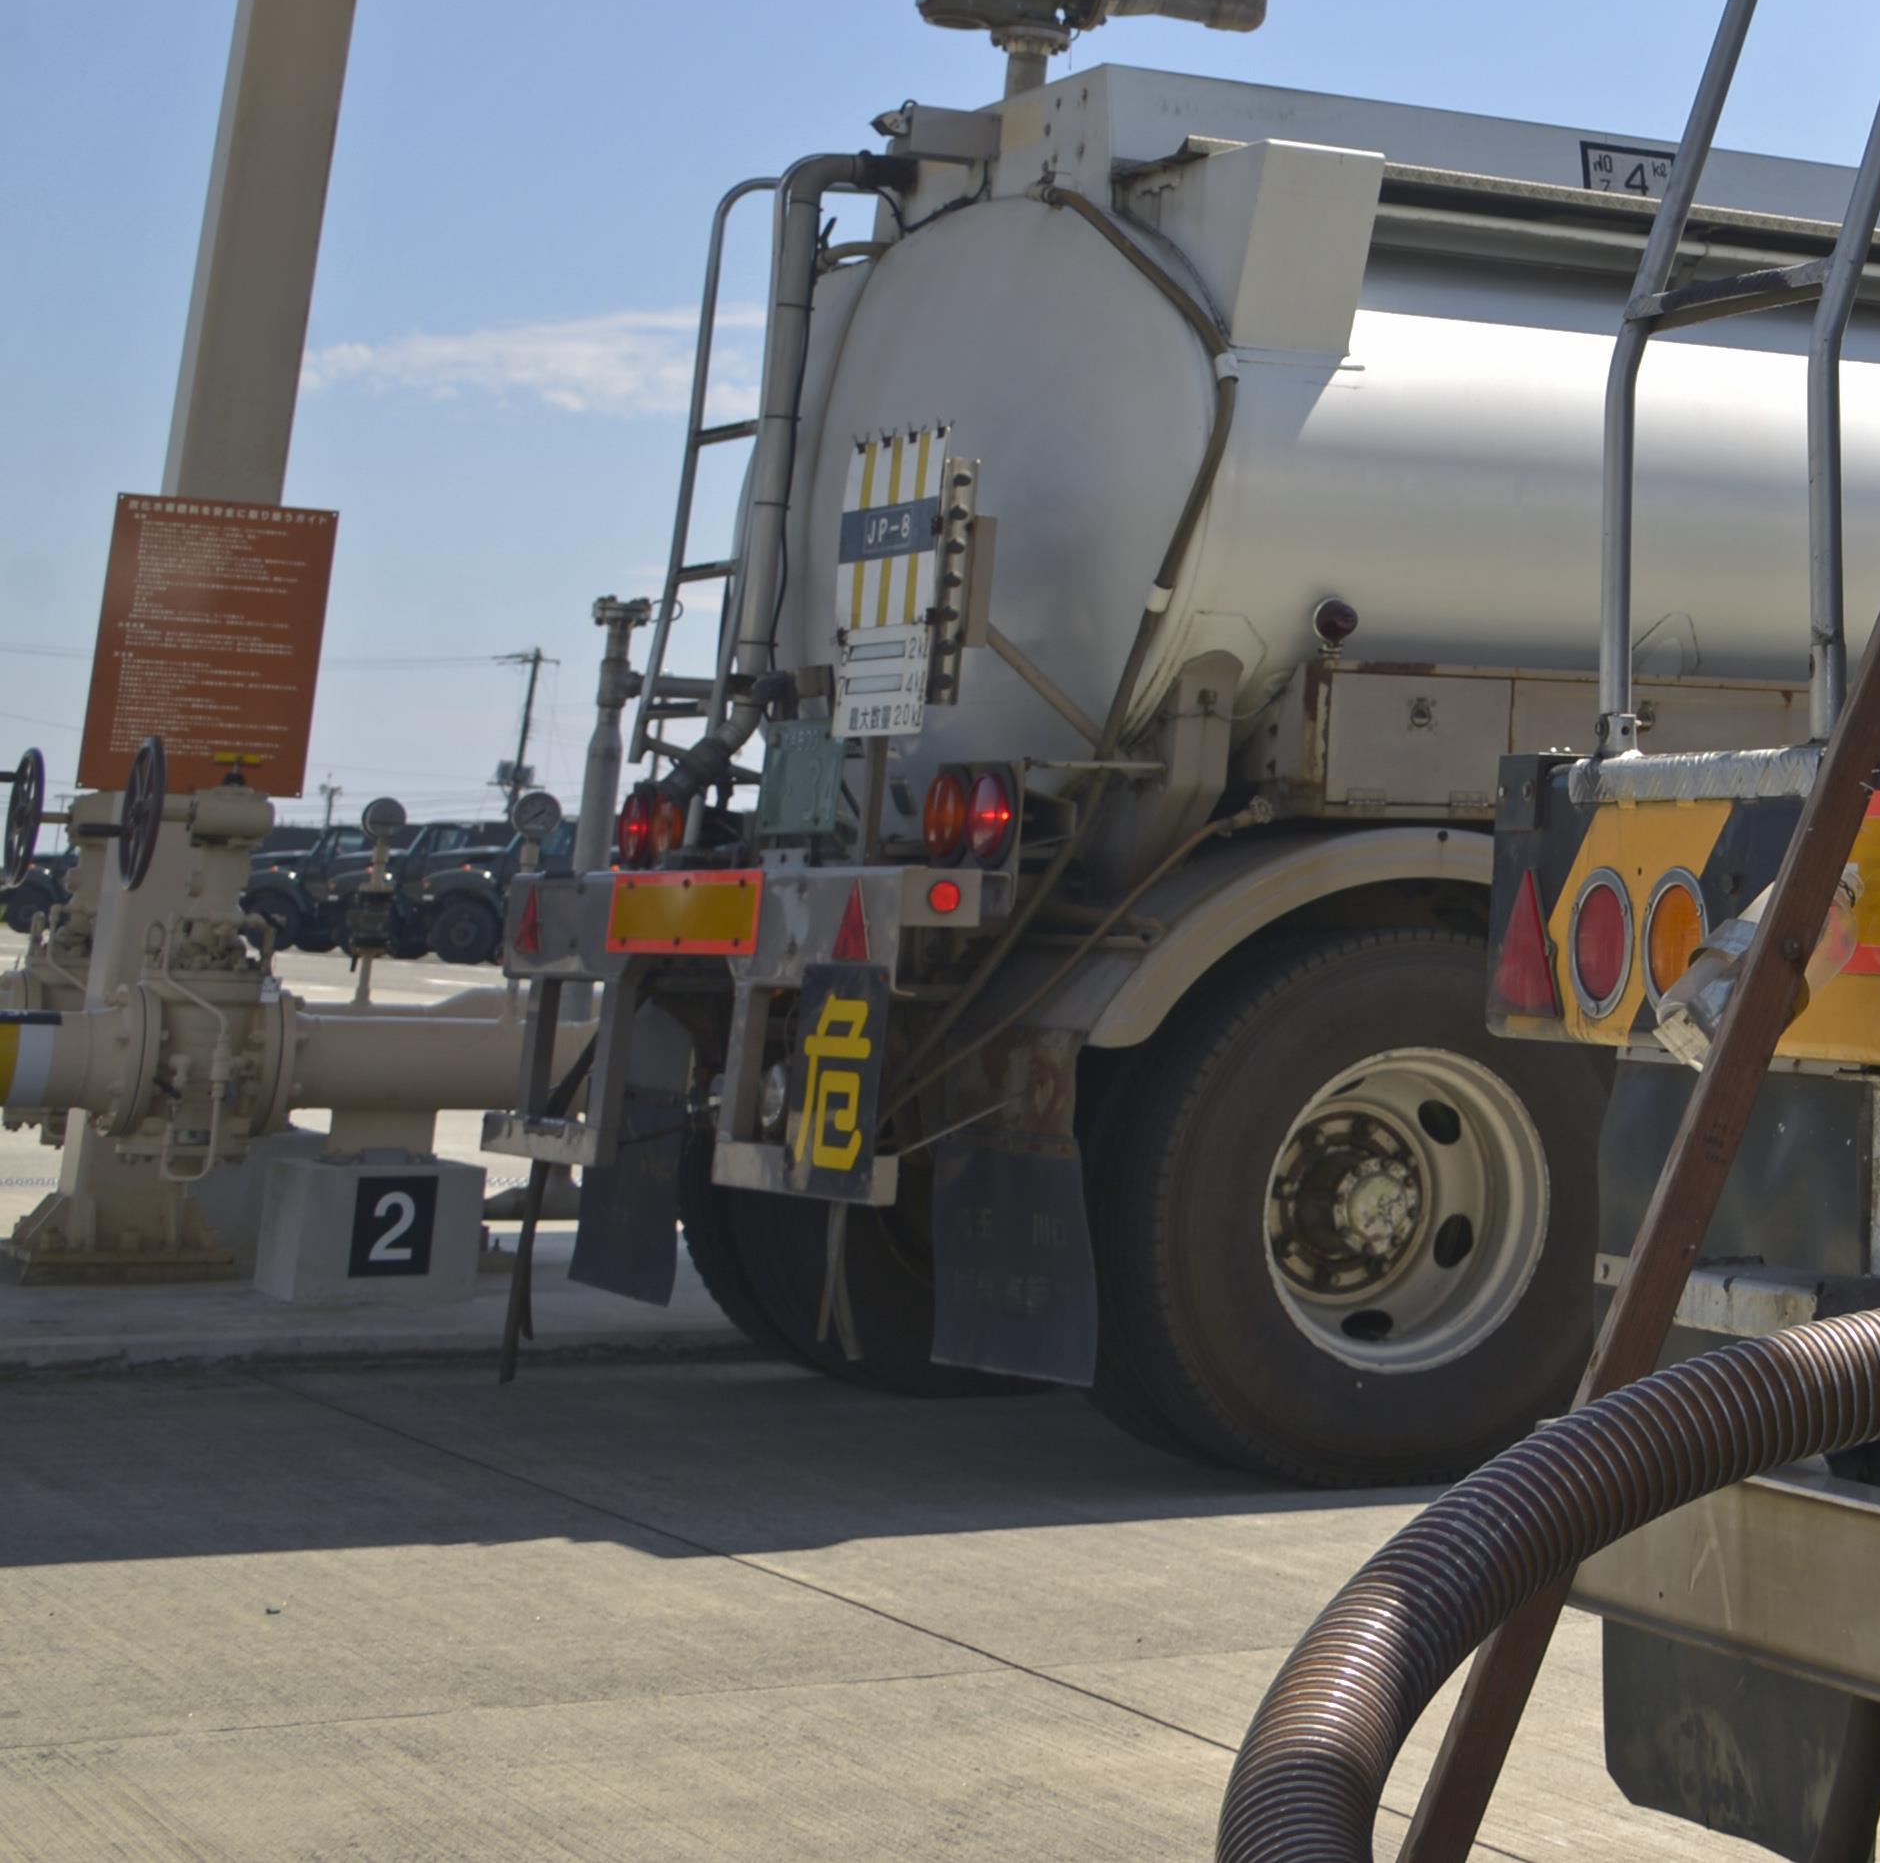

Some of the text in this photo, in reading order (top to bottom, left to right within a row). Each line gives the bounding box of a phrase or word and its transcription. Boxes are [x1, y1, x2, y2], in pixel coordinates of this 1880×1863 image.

[1624, 163, 1650, 196] 4
[866, 513, 911, 546] JP-8
[796, 994, 872, 1171] 危
[368, 1191, 416, 1262] 2
